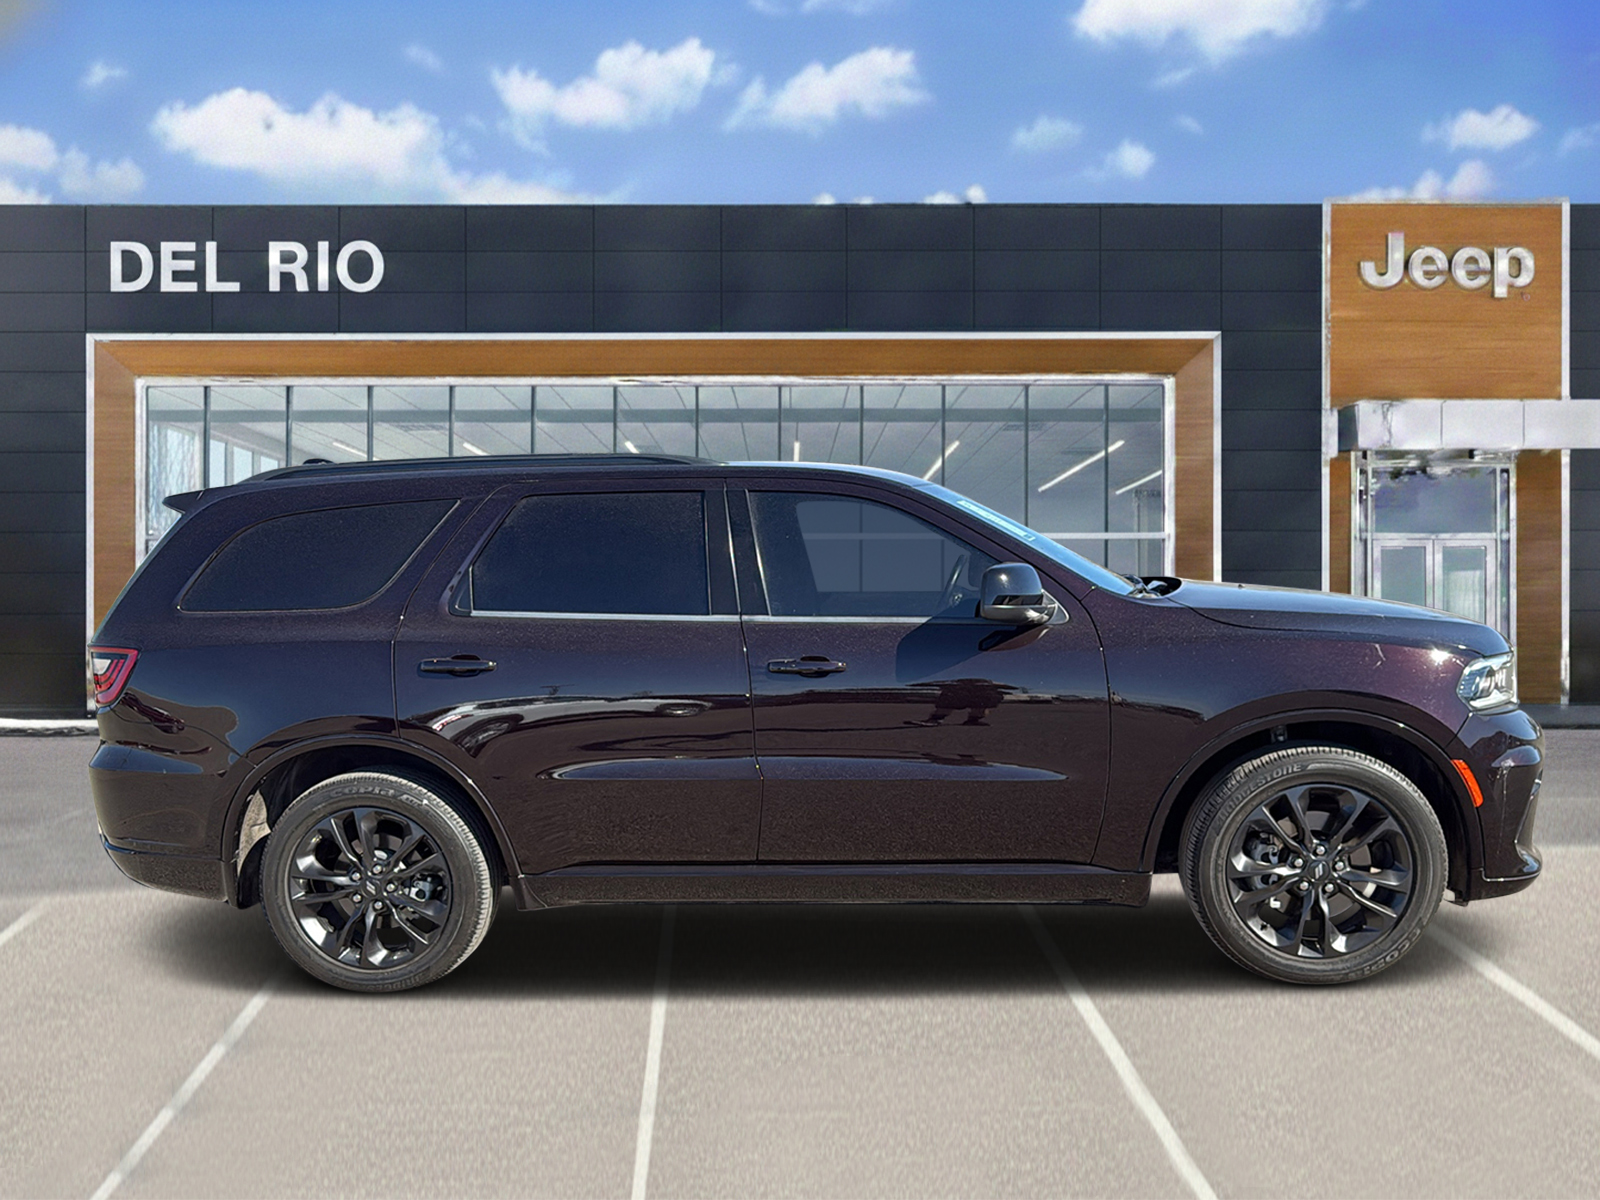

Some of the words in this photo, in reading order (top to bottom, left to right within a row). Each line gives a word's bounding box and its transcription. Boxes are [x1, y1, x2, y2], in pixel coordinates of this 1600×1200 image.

[110, 241, 240, 292] DEL
[268, 240, 385, 293] RIO
[1360, 231, 1535, 298] Jeep
